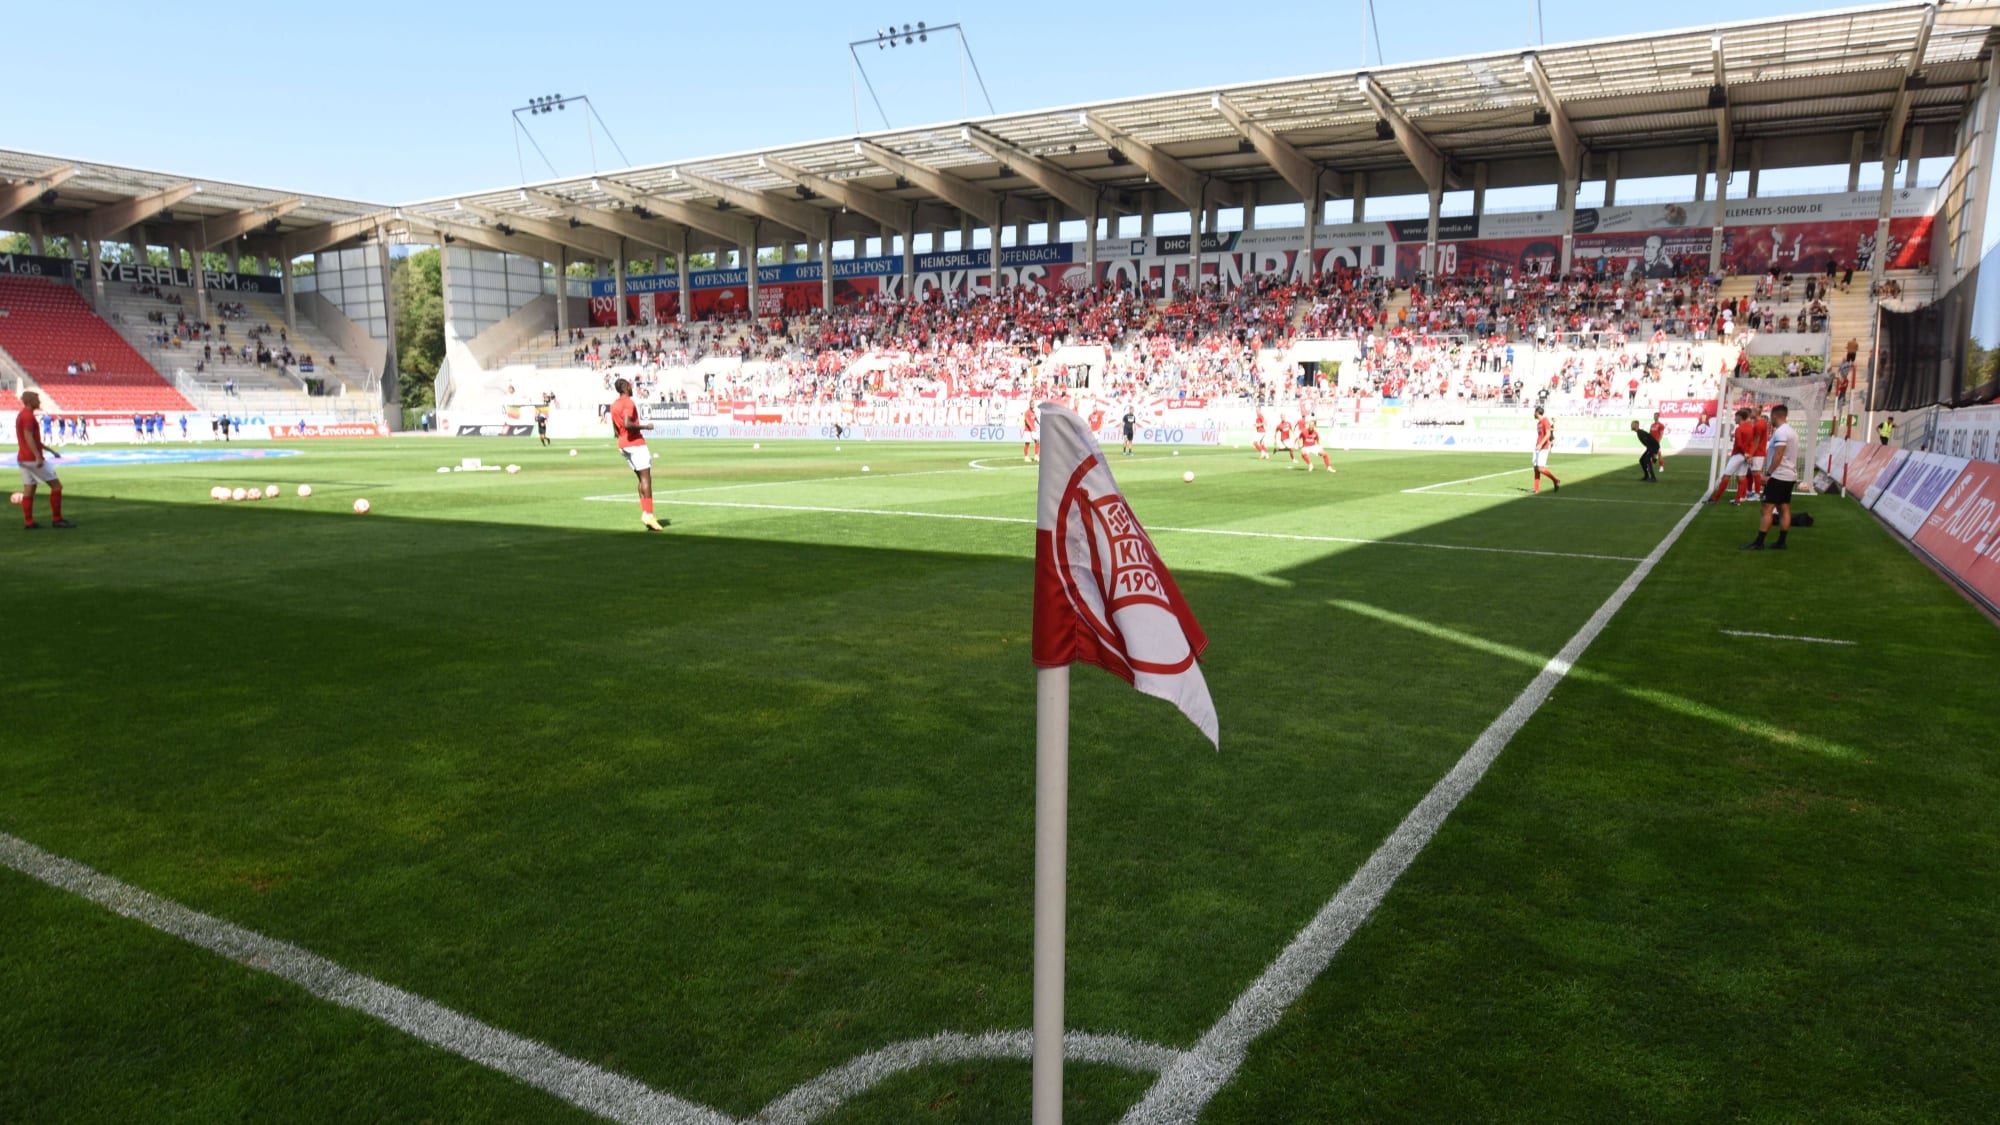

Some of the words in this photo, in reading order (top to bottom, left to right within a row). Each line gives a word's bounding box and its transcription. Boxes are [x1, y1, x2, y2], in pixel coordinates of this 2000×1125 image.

[1725, 203, 1823, 218] ELEMENTS-SHOW.DE
[1403, 224, 1473, 235] www.dmedia.de
[920, 254, 974, 269] HEIMSPIEL.
[977, 250, 992, 265] FÜ
[1418, 243, 1457, 275] 170
[604, 277, 681, 293] OFNBACH-POST
[879, 264, 1050, 310] KCKERS
